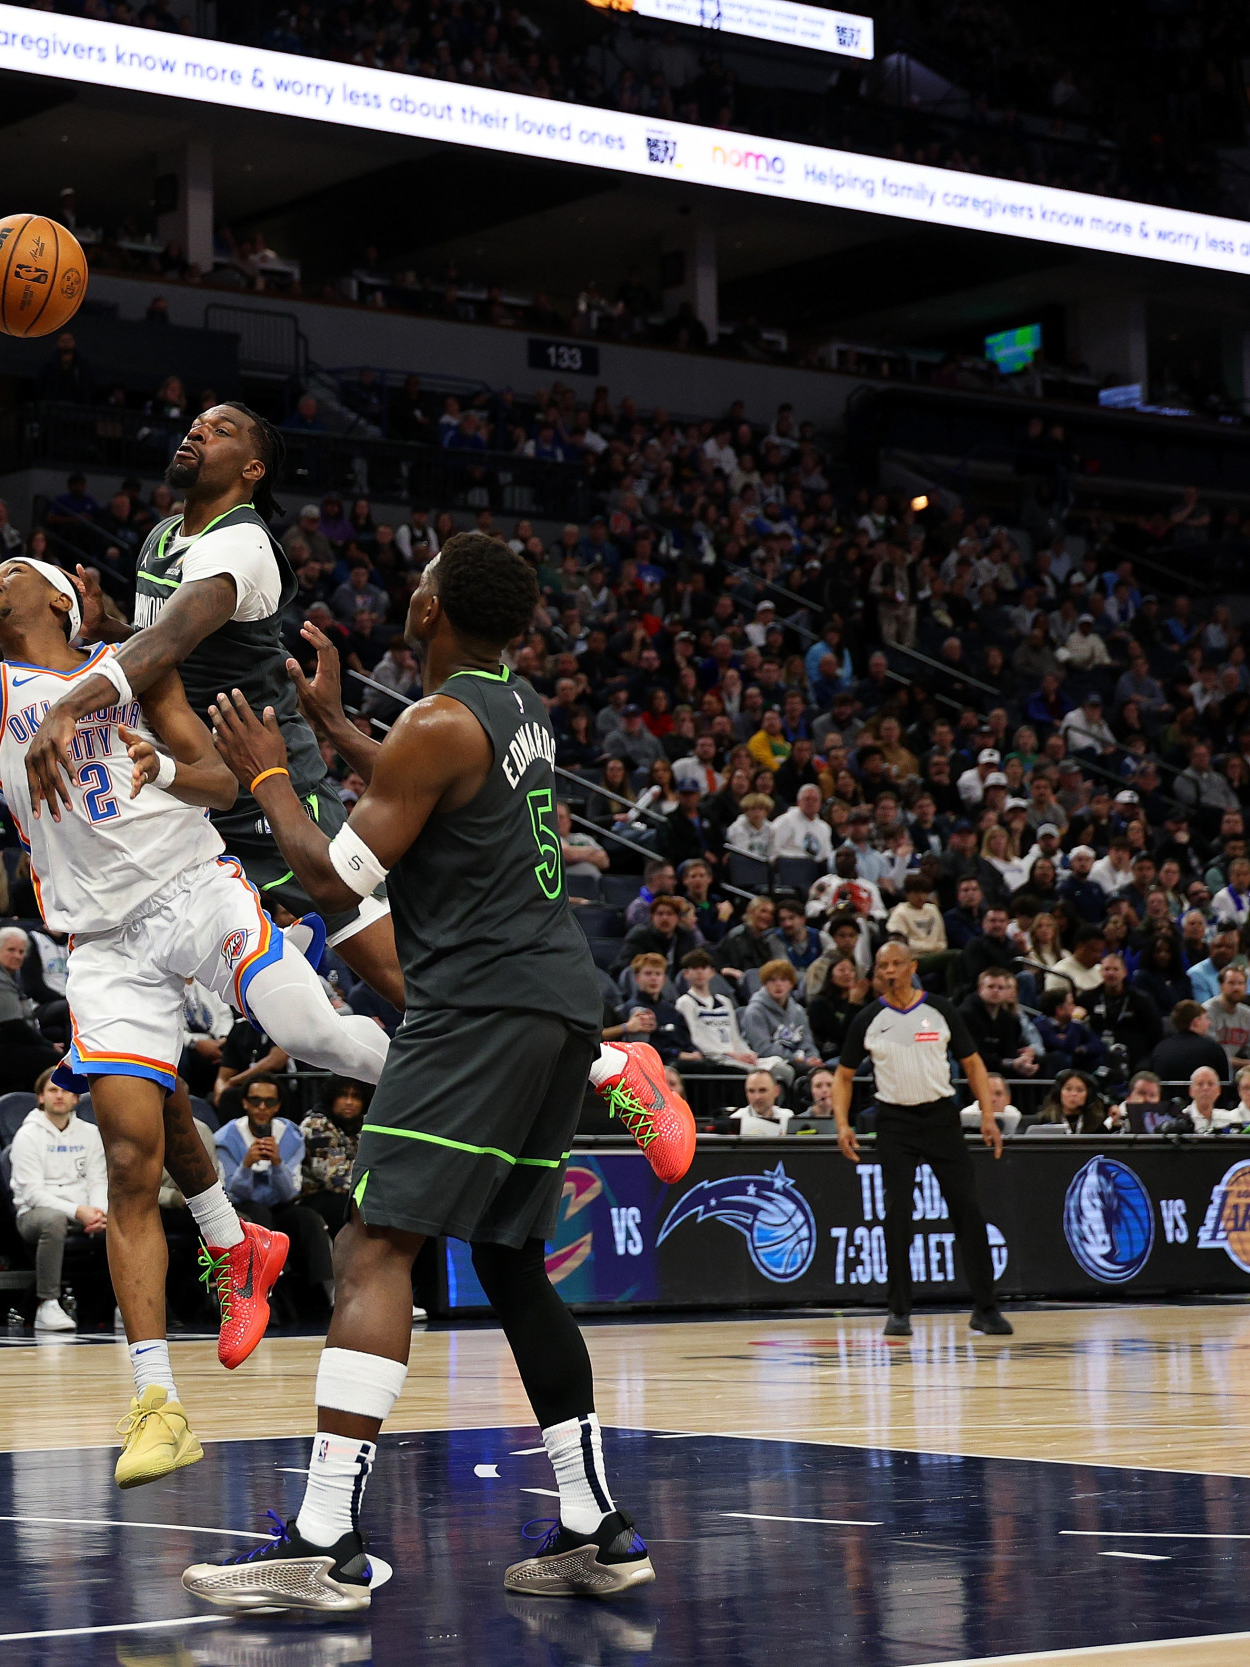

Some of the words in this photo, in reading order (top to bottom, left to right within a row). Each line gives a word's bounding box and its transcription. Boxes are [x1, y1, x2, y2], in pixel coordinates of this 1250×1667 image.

[115, 44, 177, 73] know
[184, 60, 242, 85] more
[251, 68, 264, 89] &
[273, 76, 335, 105] worry
[342, 82, 382, 109] less
[389, 94, 454, 121] about
[461, 105, 510, 130] their
[515, 112, 572, 141] loved
[578, 129, 625, 151] ones
[712, 145, 786, 174] nomo
[803, 163, 876, 198] Helping
[881, 176, 937, 207] family
[942, 190, 1034, 220] caregivers
[1040, 204, 1084, 228] know
[1090, 217, 1132, 237] more
[1138, 220, 1149, 240] &
[1154, 228, 1200, 251] worry
[1205, 232, 1235, 255] less
[547, 344, 582, 371] 133
[67, 724, 113, 761] ITY
[76, 760, 121, 826] 2
[526, 788, 562, 899] 5
[610, 1206, 644, 1256] VS
[1159, 1198, 1188, 1244] VS
[830, 1225, 888, 1285] 7:30
[928, 1232, 956, 1283] ET
